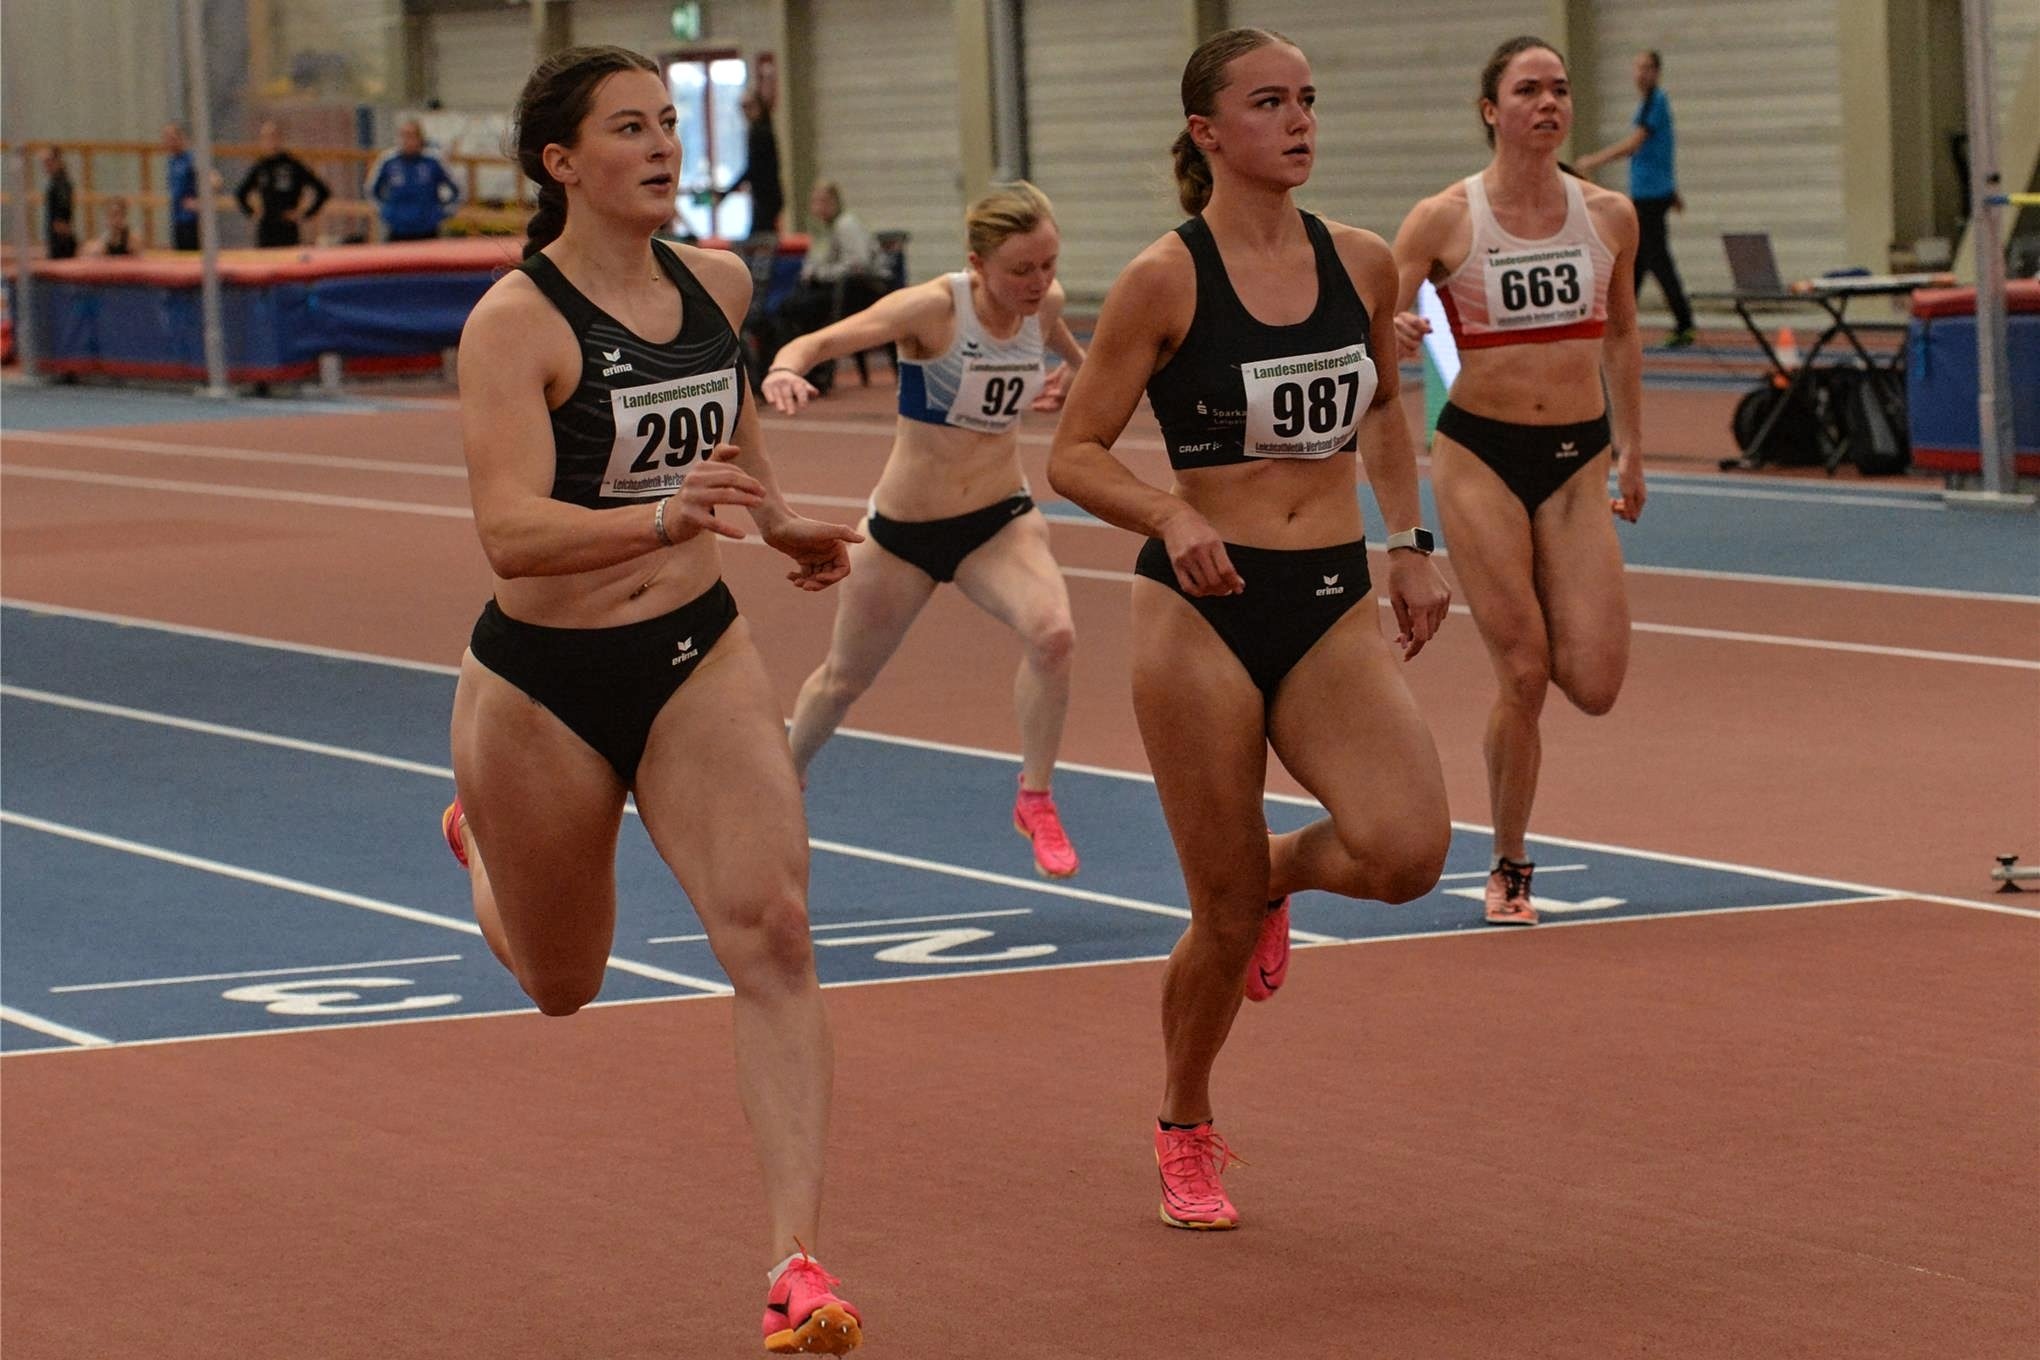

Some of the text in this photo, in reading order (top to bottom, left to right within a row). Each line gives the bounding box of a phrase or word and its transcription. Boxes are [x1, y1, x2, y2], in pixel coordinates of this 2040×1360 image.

[1501, 264, 1580, 311] 663
[602, 363, 632, 377] erima
[623, 377, 729, 409] Landesmeisterschaft
[982, 377, 1024, 416] 92
[1273, 371, 1360, 438] 987
[630, 401, 724, 473] 299
[1179, 442, 1212, 453] CRAFT
[1316, 586, 1344, 597] erima
[813, 926, 1058, 964] 2
[221, 976, 462, 1016] 3
